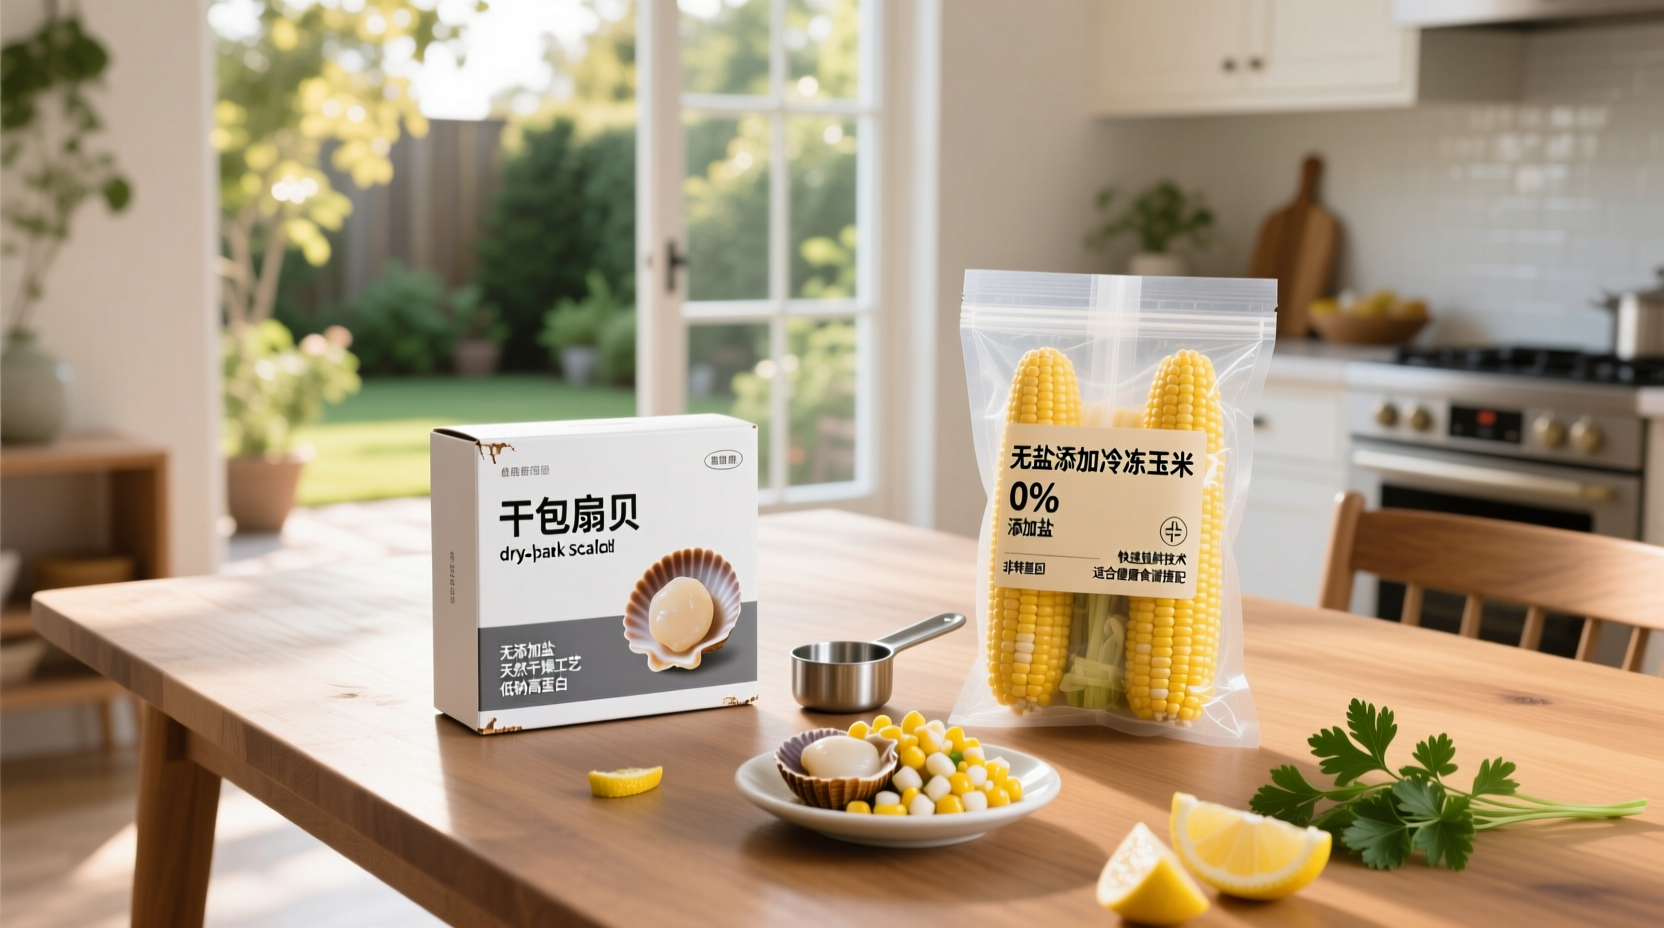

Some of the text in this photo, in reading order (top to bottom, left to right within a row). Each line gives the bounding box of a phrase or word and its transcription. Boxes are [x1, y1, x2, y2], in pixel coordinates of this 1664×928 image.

[1009, 444, 1194, 479] 无盐添加冷冻玉米
[1009, 480, 1060, 514] 0%
[499, 493, 640, 538] 干包扇贝
